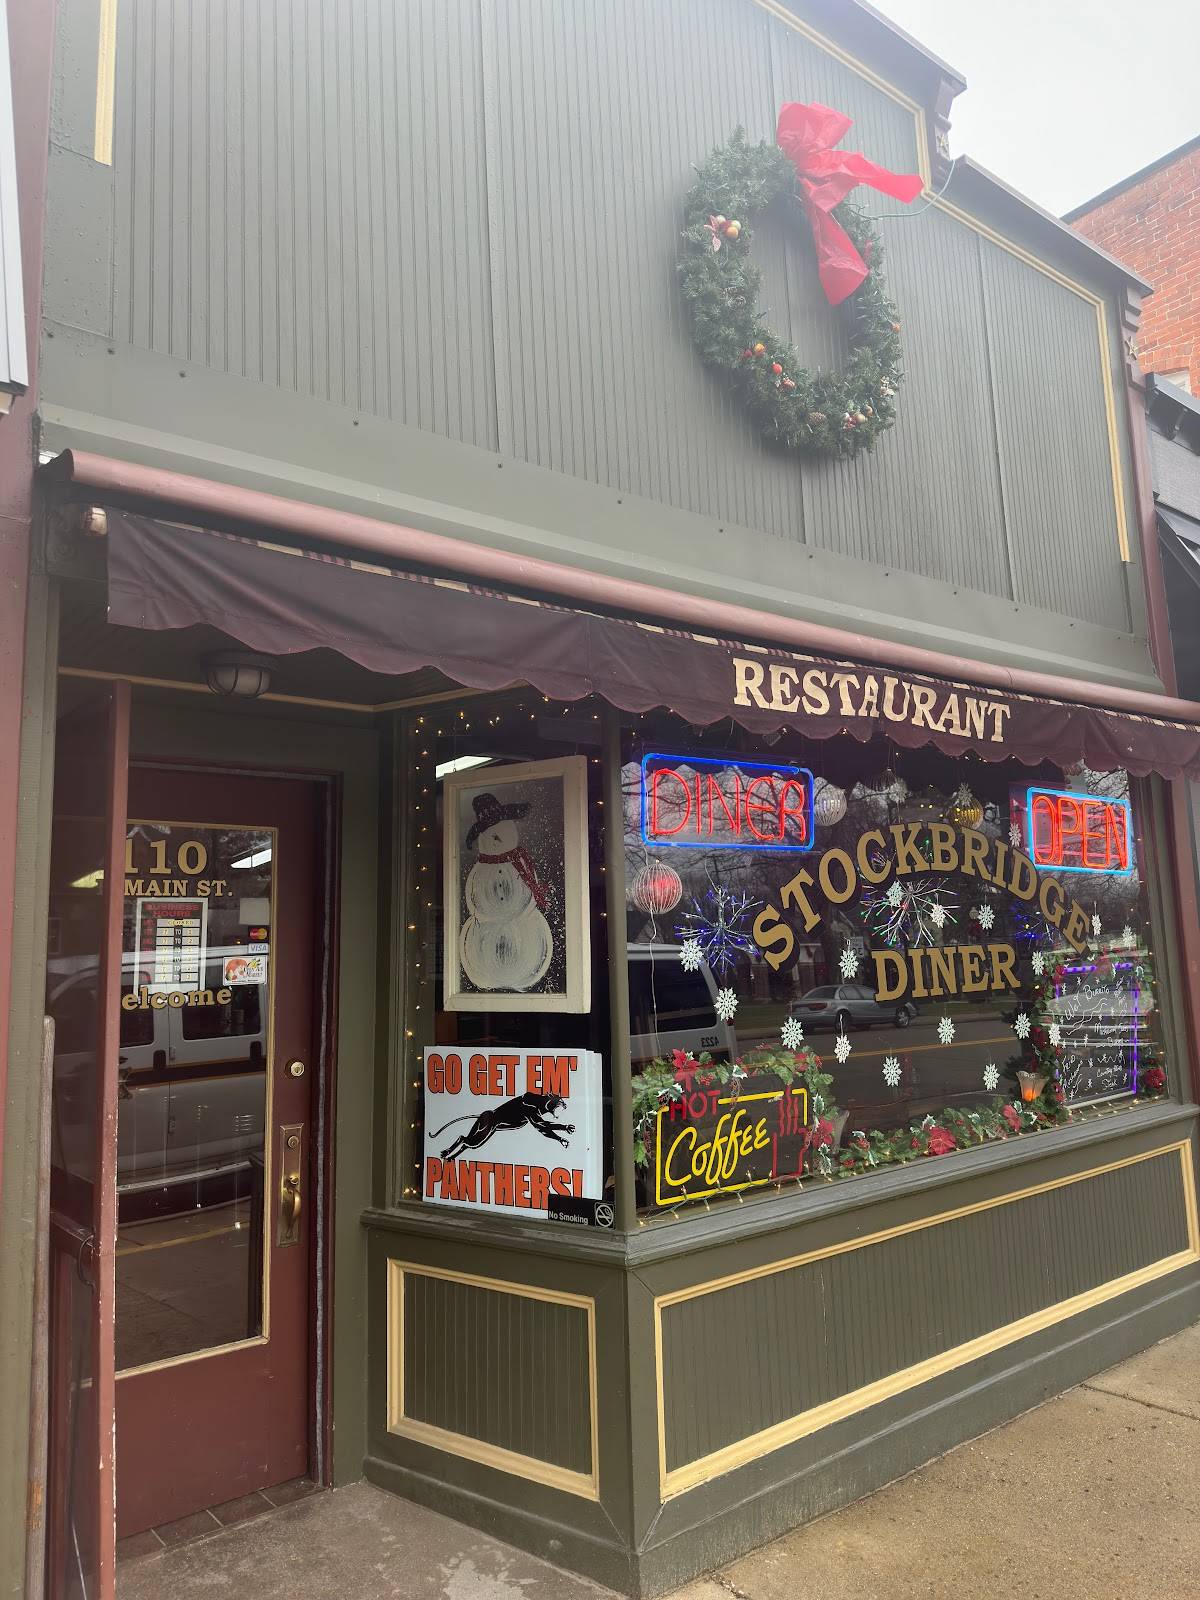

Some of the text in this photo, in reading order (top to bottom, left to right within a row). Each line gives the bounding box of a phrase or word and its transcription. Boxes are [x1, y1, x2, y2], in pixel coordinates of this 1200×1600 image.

[733, 657, 1011, 743] RESTAURANT
[652, 768, 807, 842] DINER
[125, 838, 208, 875] 110
[1032, 795, 1128, 870] OPEN
[124, 879, 234, 897] MAIN ST.
[752, 822, 1092, 972] STOCKBRIDGE
[251, 944, 267, 952] VISA
[871, 943, 1021, 1002] DINER
[121, 985, 232, 1011] elcome
[427, 1053, 578, 1099] GO GET EM'
[668, 1090, 721, 1121] HOT
[665, 1109, 770, 1186] Coffee
[425, 1156, 584, 1210] PANTHERS!
[548, 1211, 589, 1225] No Smoking
